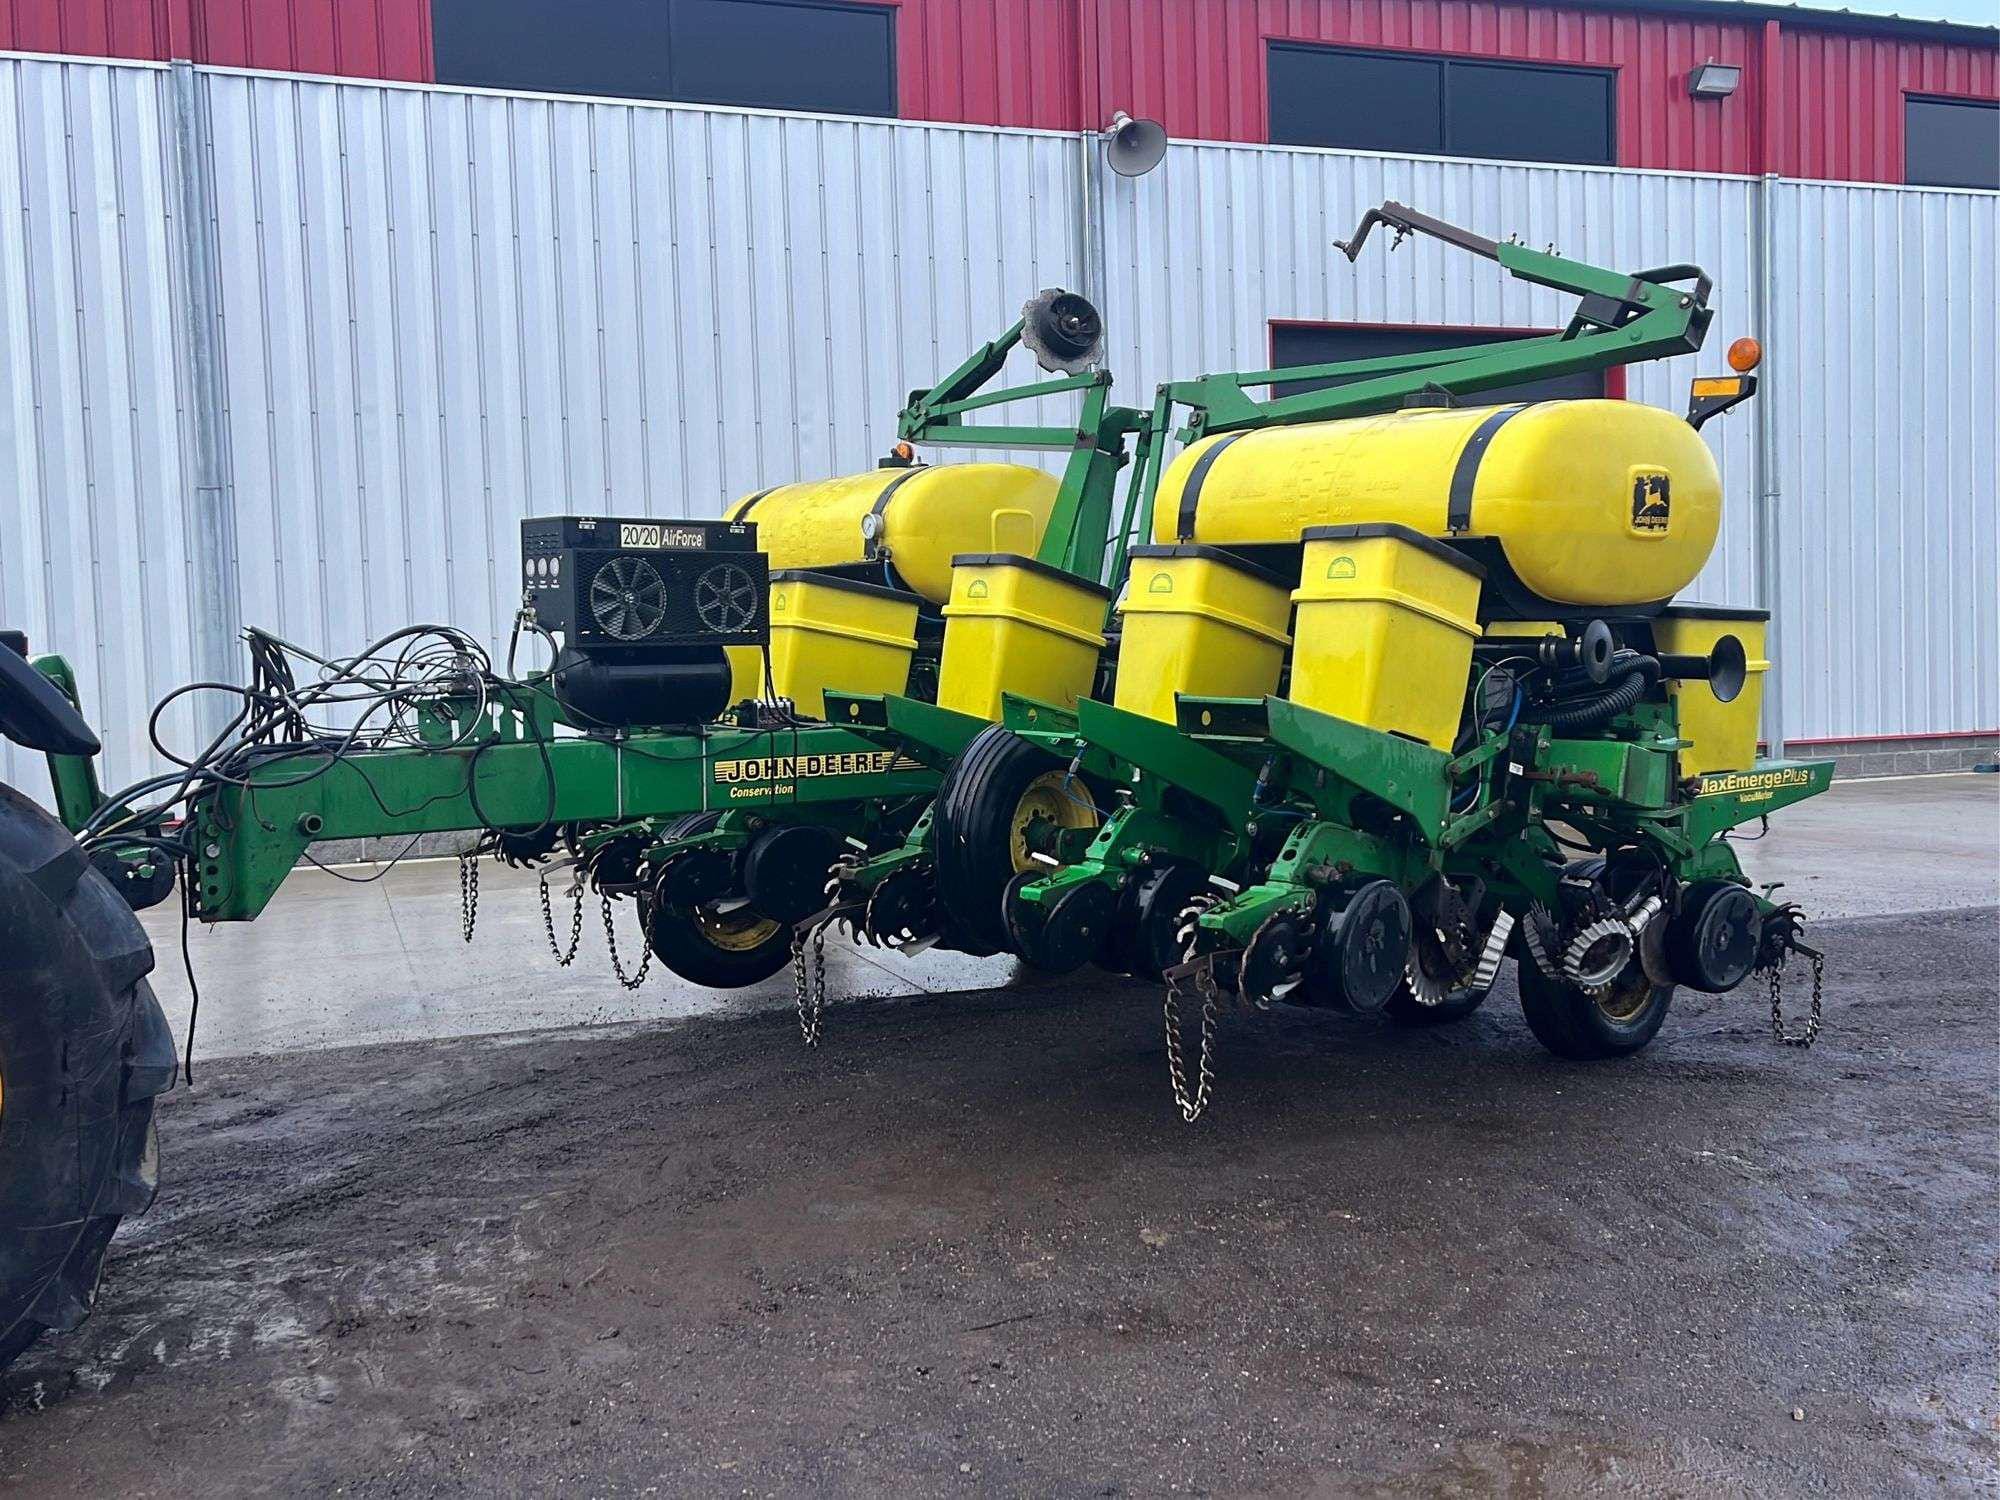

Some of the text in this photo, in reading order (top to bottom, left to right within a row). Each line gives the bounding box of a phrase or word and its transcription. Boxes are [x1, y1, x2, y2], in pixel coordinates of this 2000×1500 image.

[622, 526, 702, 547] 20/20 AirForce
[727, 752, 885, 782] JOHN DEERE
